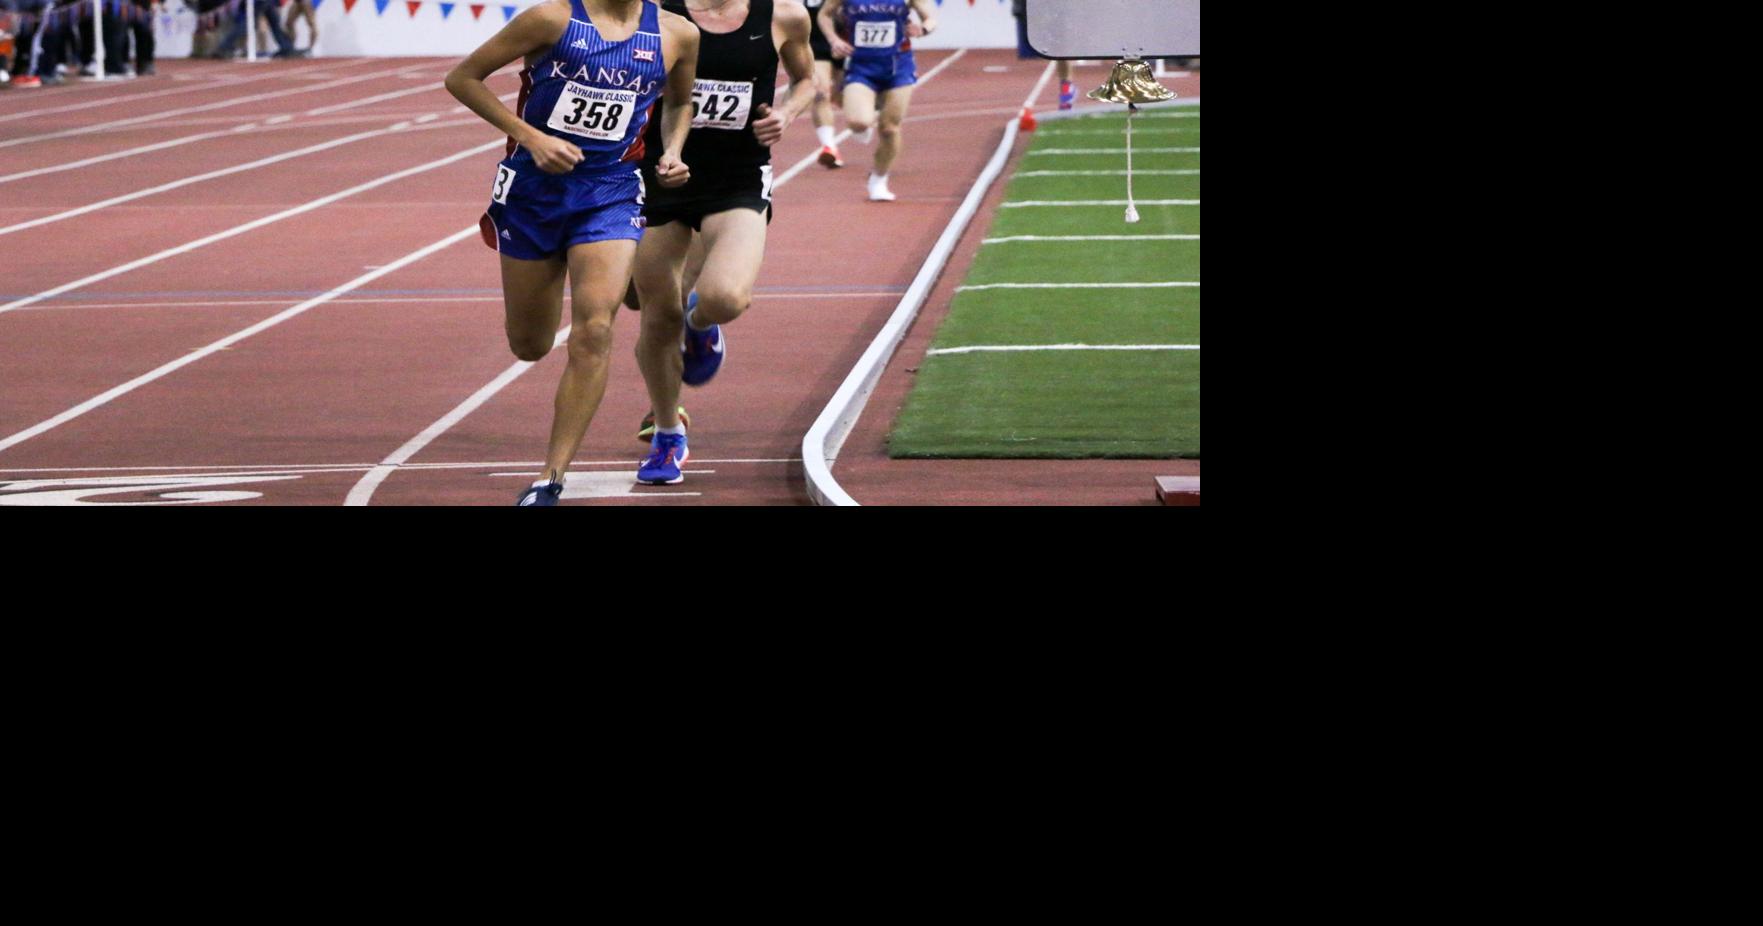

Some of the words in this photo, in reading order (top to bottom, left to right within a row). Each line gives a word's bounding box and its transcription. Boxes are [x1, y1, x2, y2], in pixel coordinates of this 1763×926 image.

[861, 29, 888, 42] 377
[549, 61, 656, 95] KANSAS
[693, 83, 715, 92] HAWK
[718, 84, 750, 93] CLASSIC
[567, 84, 604, 100] JAYHAWK
[605, 92, 634, 103] CLASSIC
[691, 92, 739, 121] 542
[563, 98, 623, 131] 358
[494, 168, 508, 200] 3
